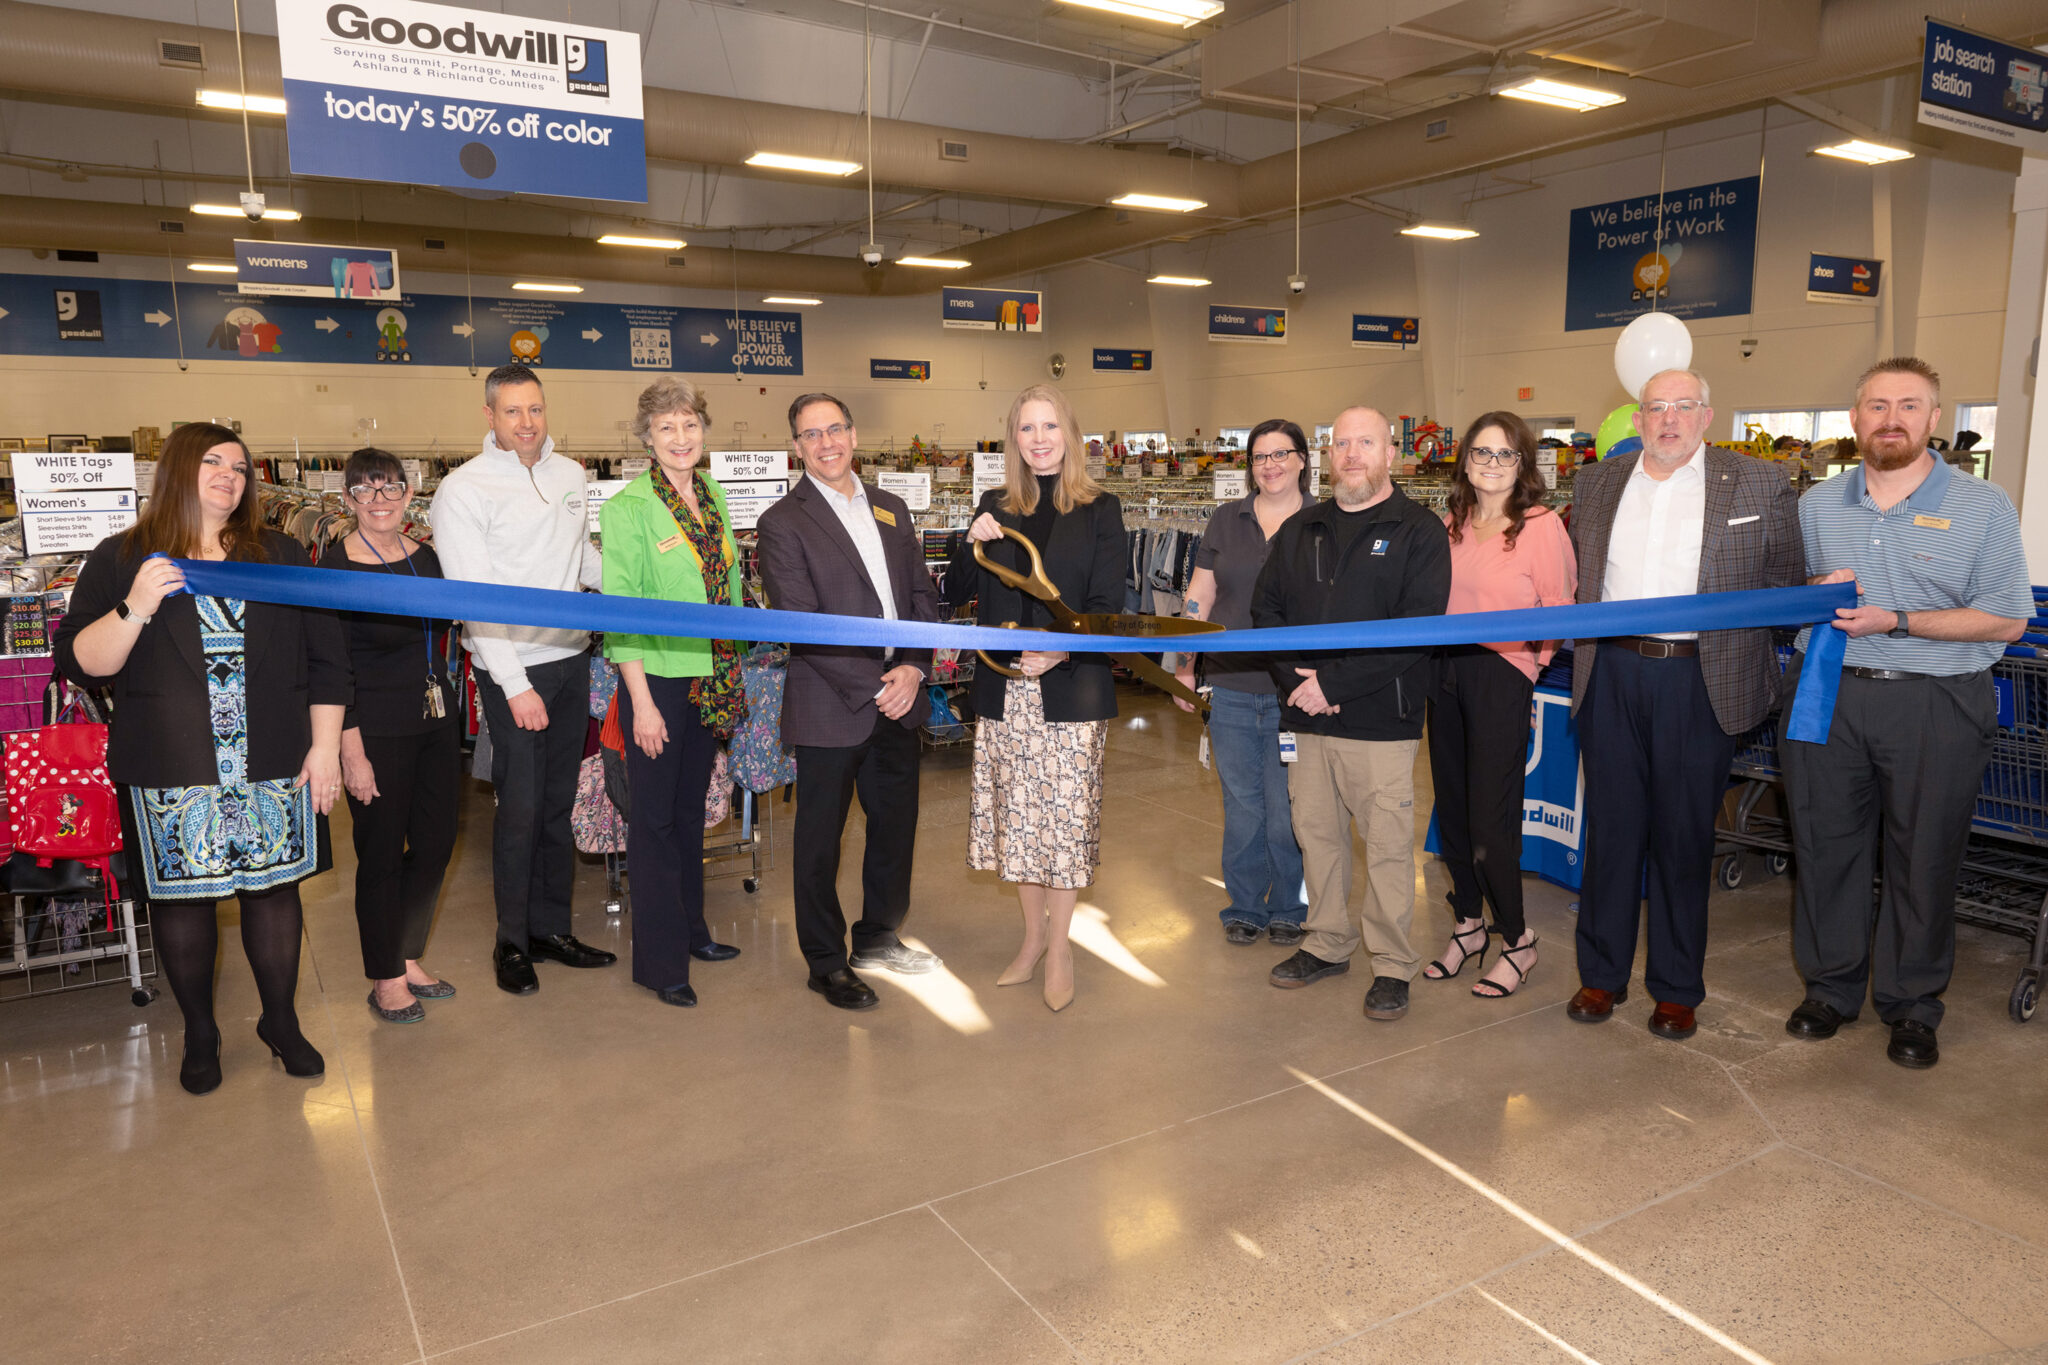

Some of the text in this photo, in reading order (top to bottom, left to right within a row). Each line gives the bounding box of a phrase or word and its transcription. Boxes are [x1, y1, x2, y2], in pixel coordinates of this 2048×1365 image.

[326, 3, 559, 65] Goodwill
[1933, 36, 1995, 75] job search
[334, 46, 560, 84] Serving Summit, Portage, Medina,
[353, 60, 545, 91] Ashland & Richland Counties
[568, 82, 608, 93] goodwill
[1931, 70, 1972, 99] station
[324, 91, 612, 146] today's 50% off color
[1590, 186, 1737, 228] We believe in the
[1597, 212, 1725, 250] Power of Work
[246, 256, 308, 270] womens
[1814, 265, 1834, 278] shoes
[950, 299, 974, 308] mens
[1215, 314, 1245, 324] childrens
[726, 318, 796, 333] WE BELIEVE
[60, 330, 102, 339] goodwill
[742, 331, 782, 344] IN THE
[739, 343, 786, 355] POWER
[732, 354, 793, 367] OF WORK
[35, 456, 113, 469] WHITE Tags
[725, 454, 774, 464] WHITE Tags
[733, 467, 767, 476] 50% Off
[50, 472, 103, 484] 50% Off
[726, 486, 756, 495] omen's
[26, 497, 87, 509] Women's
[38, 524, 71, 532] Sleeveless
[11, 604, 41, 613] $10.00
[12, 613, 41, 621] $15.00
[13, 621, 42, 629] $20.00
[1112, 620, 1162, 631] City of Green
[14, 630, 43, 638] $25.00
[15, 638, 44, 647] $30.00
